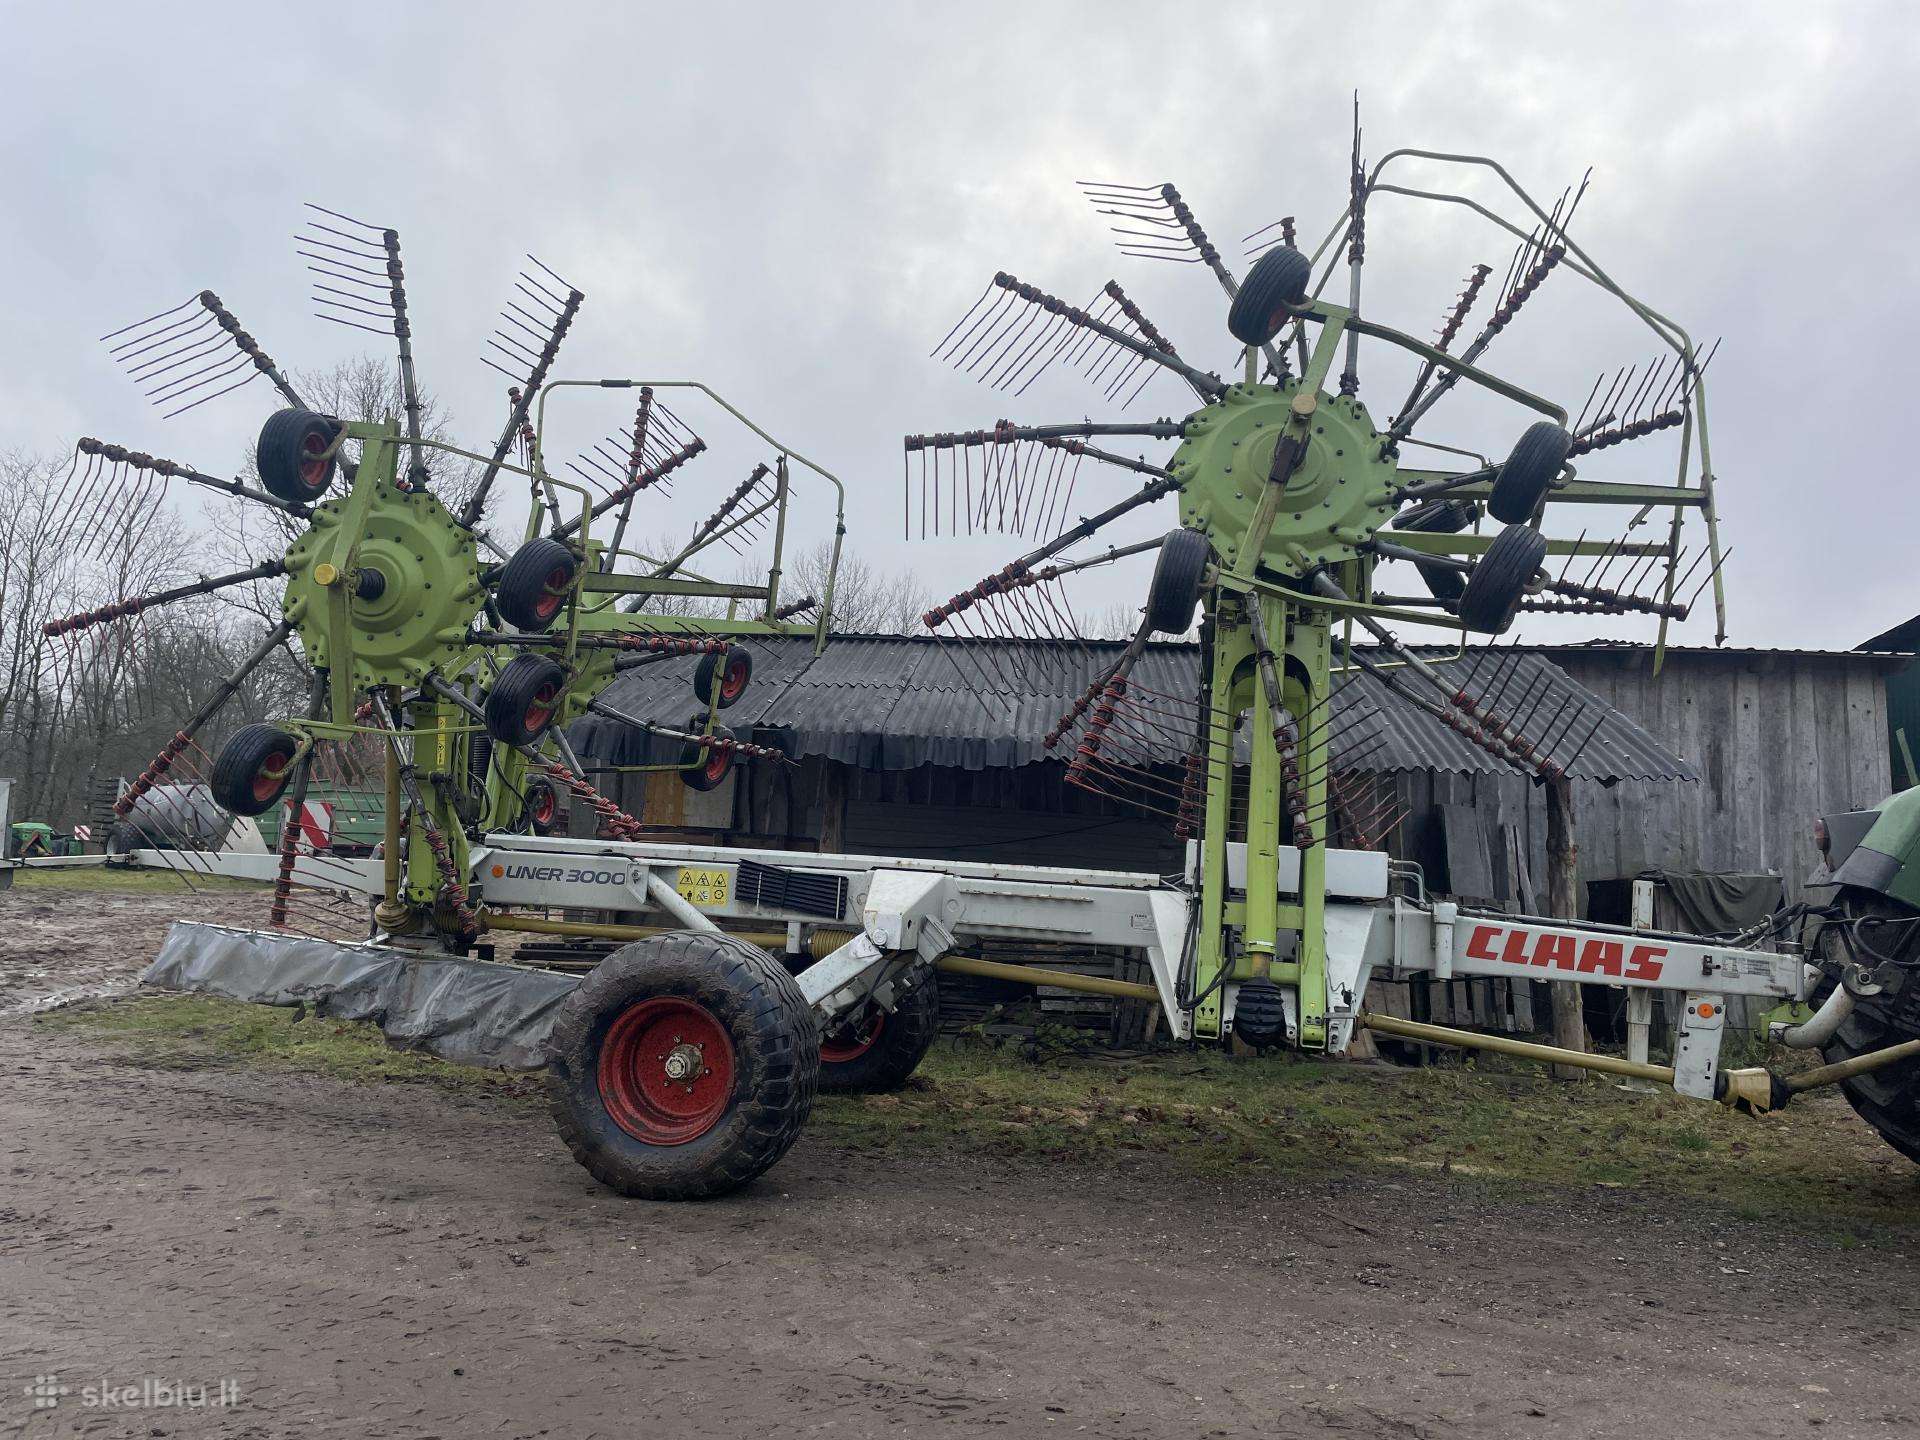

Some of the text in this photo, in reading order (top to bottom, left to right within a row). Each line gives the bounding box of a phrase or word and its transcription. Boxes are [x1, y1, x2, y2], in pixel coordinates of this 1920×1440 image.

[506, 865, 626, 886] LINER 3000
[1466, 925, 1668, 982] CLAAS
